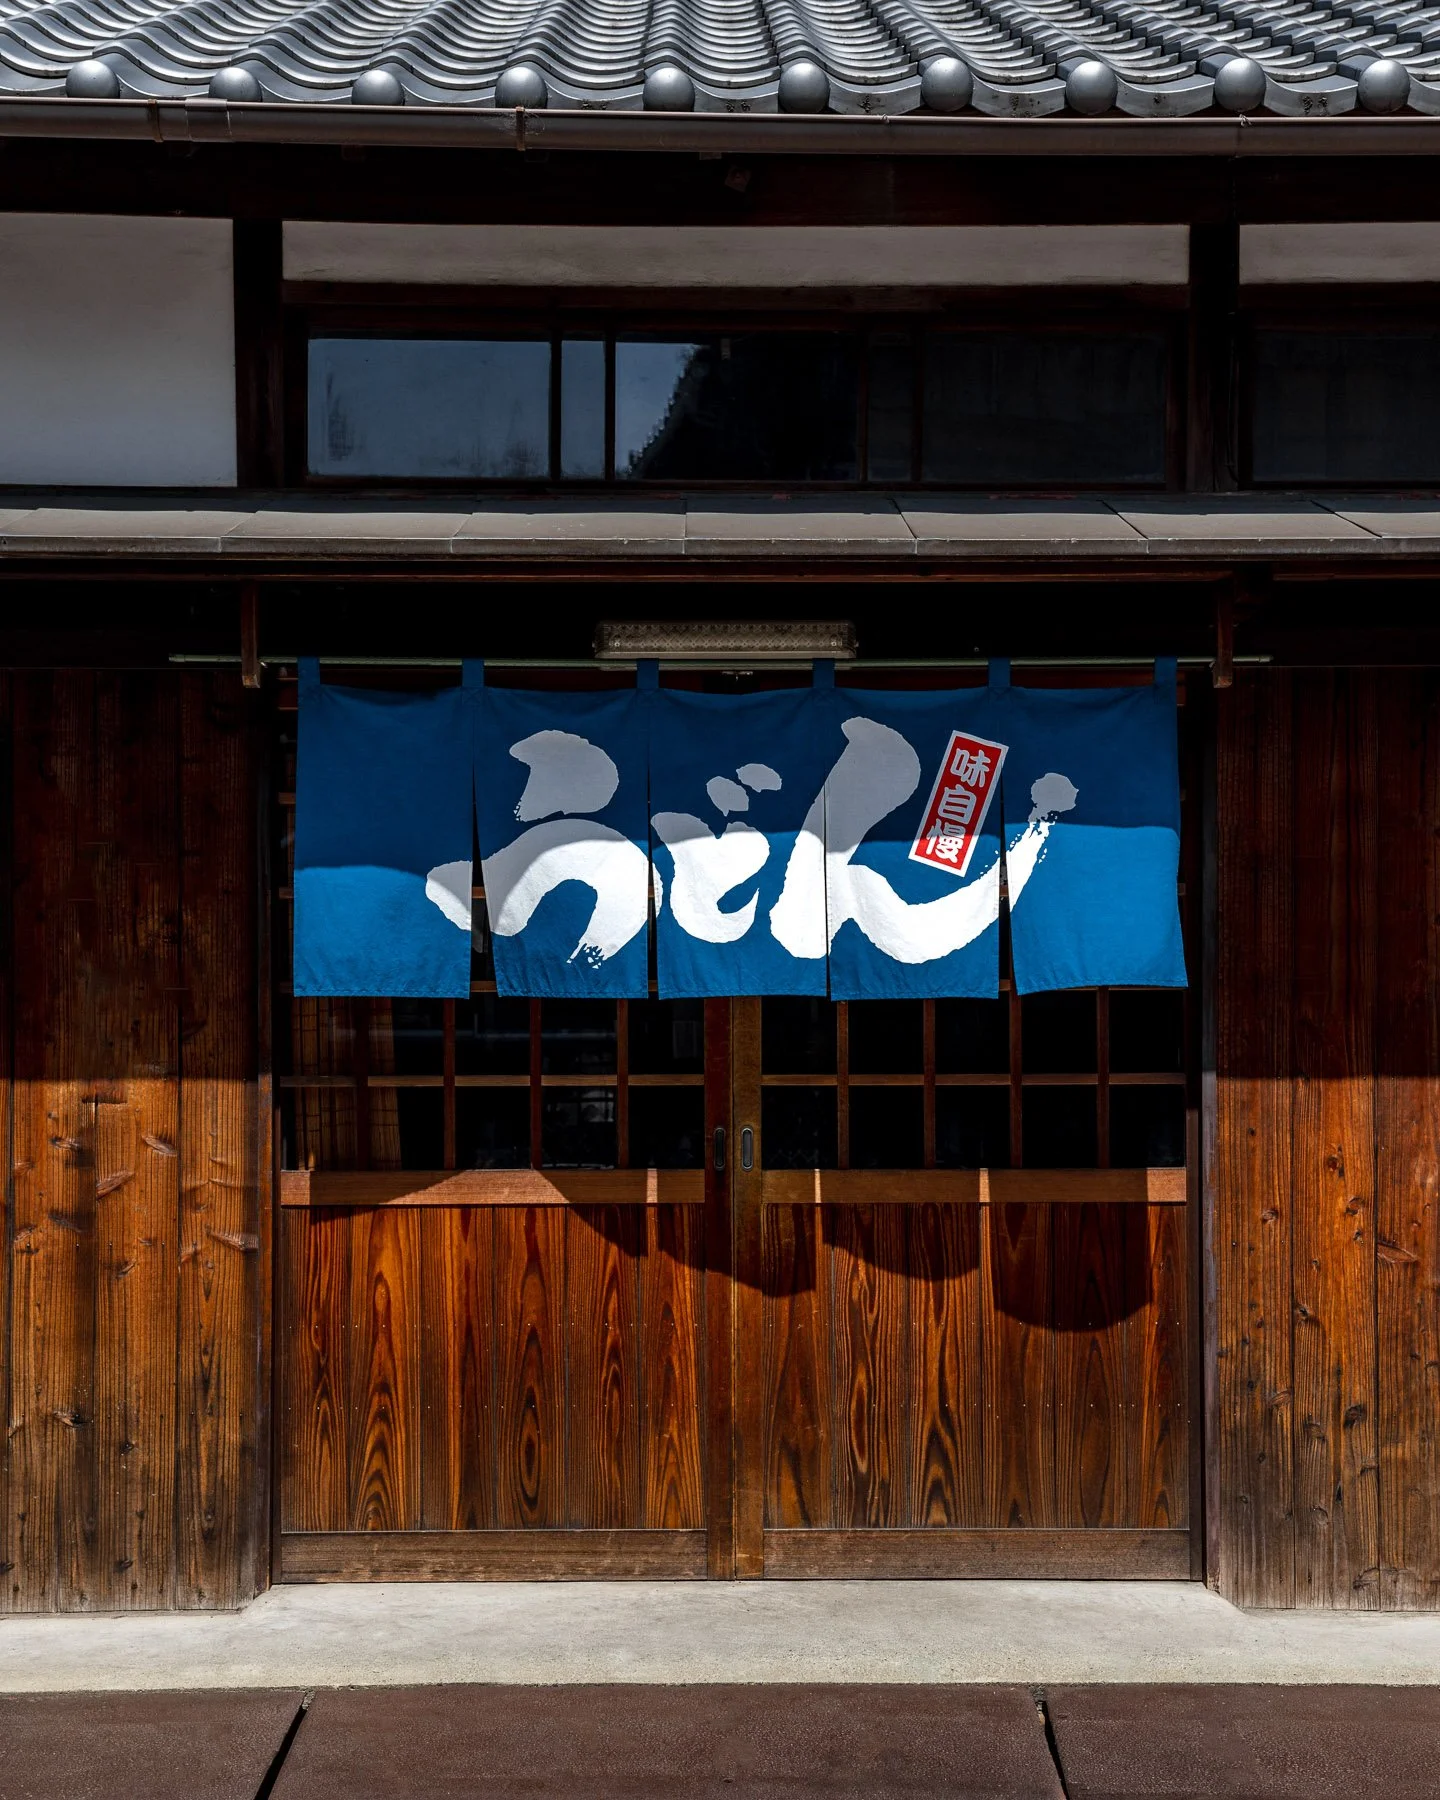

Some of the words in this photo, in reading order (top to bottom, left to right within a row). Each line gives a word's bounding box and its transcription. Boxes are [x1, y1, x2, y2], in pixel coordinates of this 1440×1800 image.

[425, 716, 1079, 968] うどん
[925, 747, 991, 863] 味自慢
